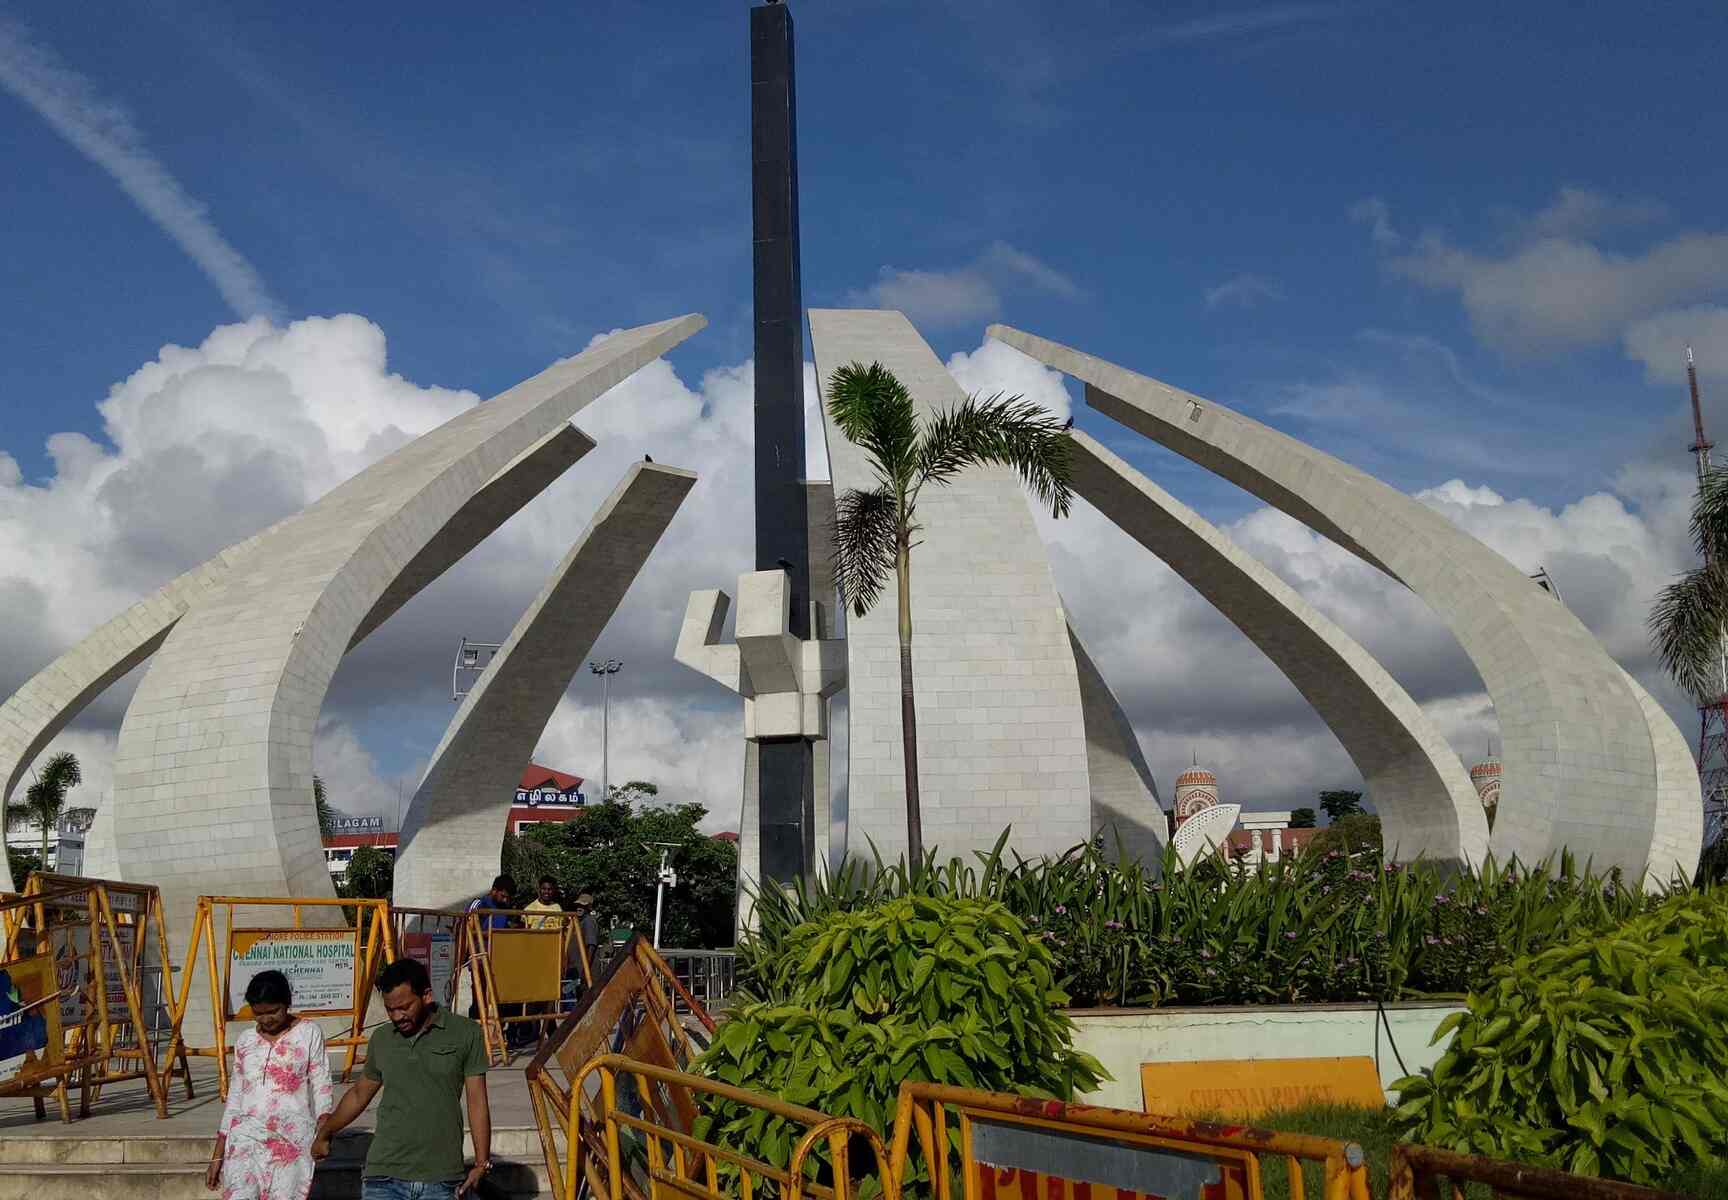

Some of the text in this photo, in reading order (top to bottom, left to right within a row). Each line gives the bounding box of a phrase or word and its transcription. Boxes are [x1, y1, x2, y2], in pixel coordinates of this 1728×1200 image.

[517, 789, 578, 805] எழிலகம்
[233, 944, 355, 960] CENNAI NATIONAL HOSPITAL
